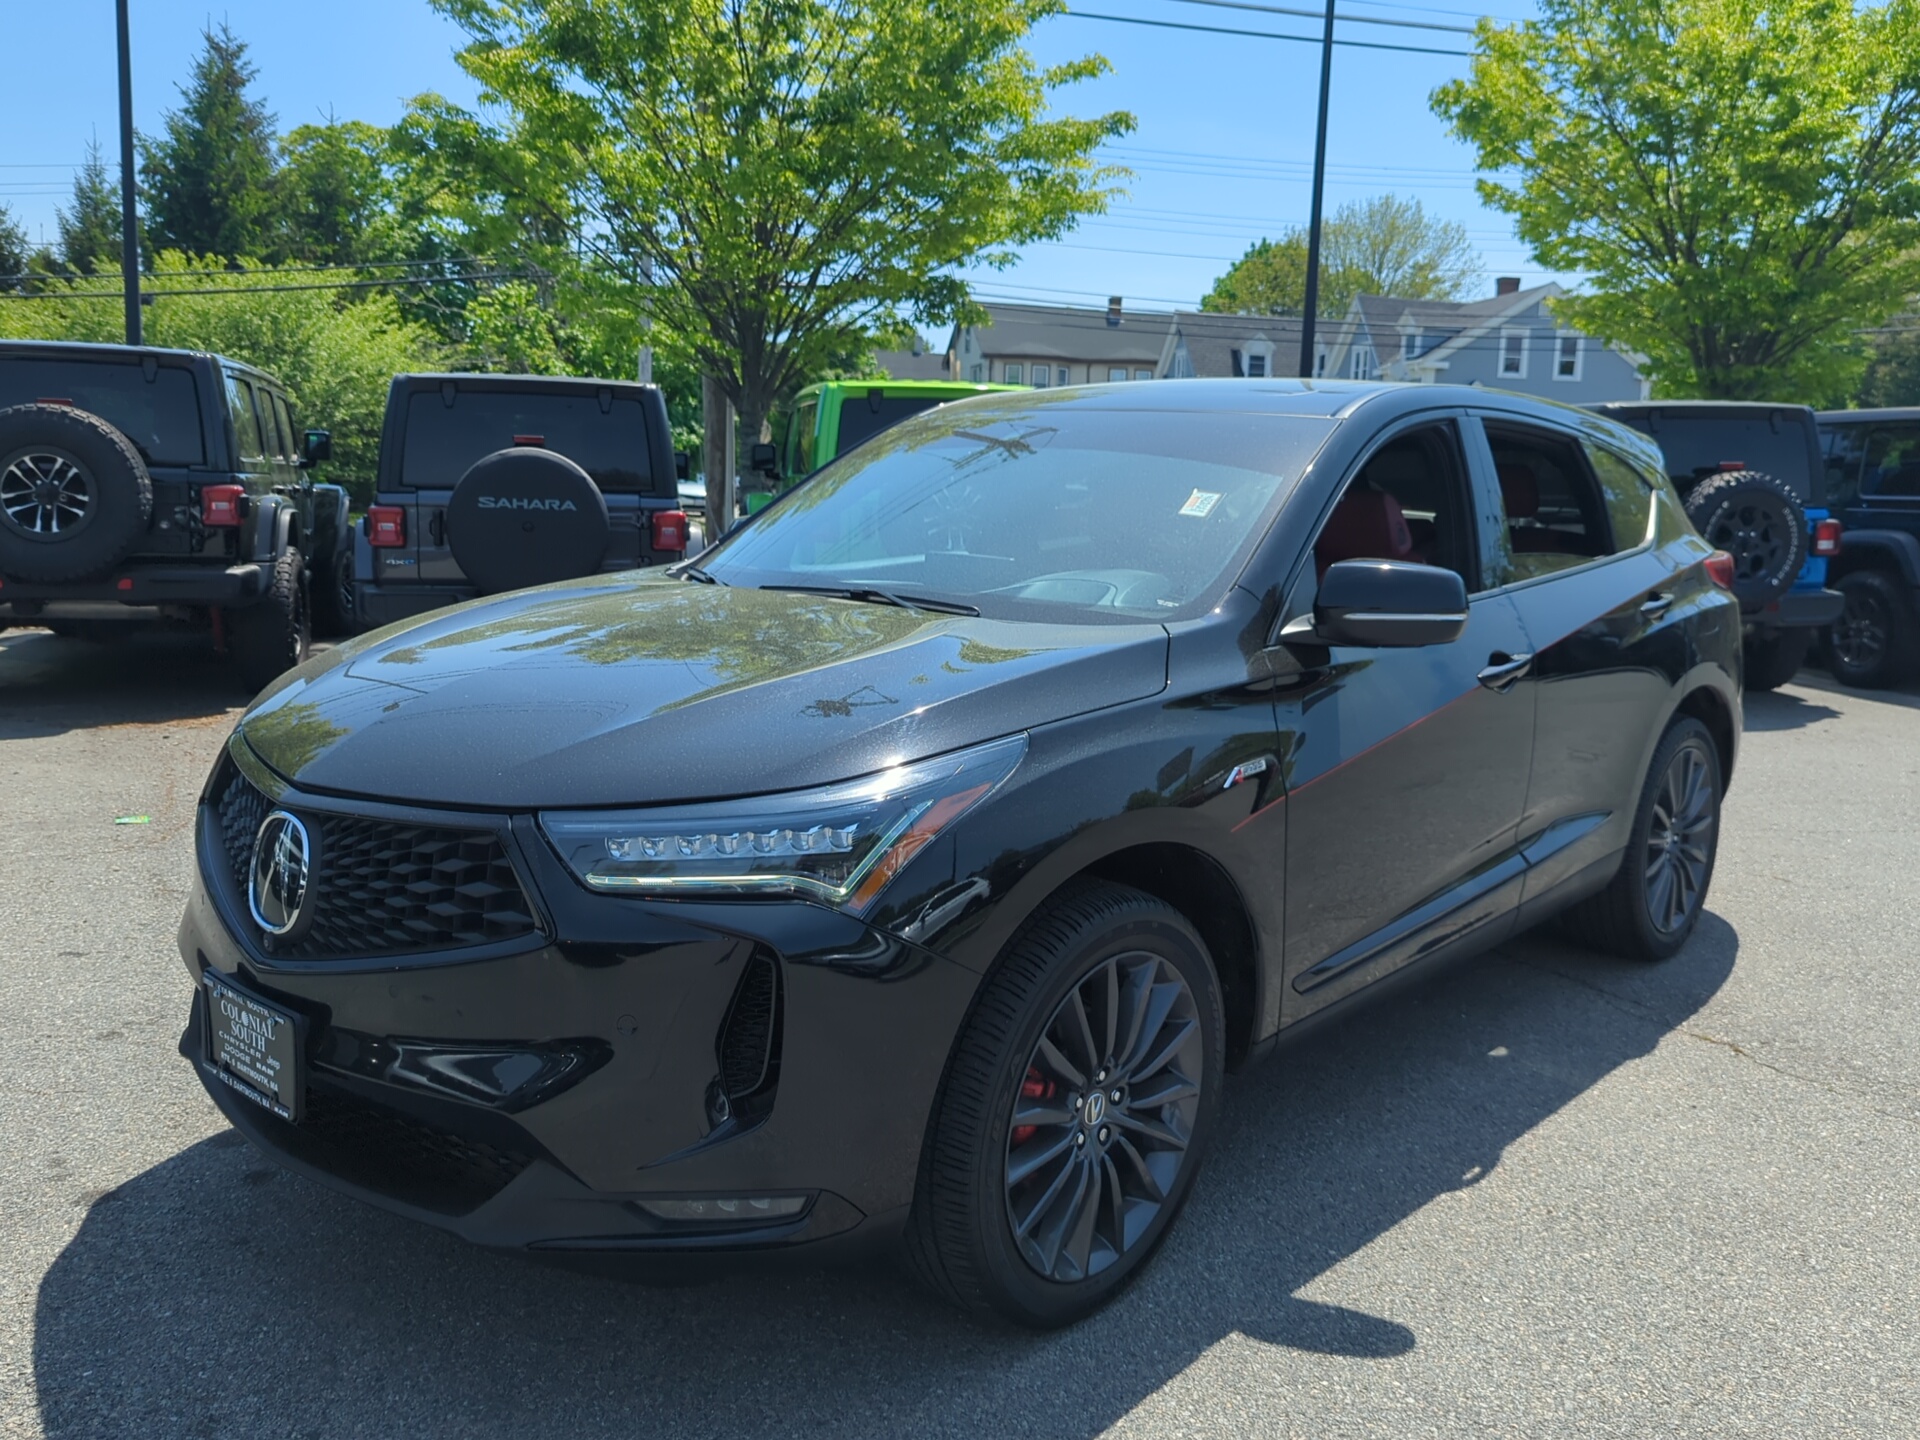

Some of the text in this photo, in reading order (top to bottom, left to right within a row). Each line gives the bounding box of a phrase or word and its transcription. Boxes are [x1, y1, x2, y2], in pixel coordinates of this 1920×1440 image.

[477, 496, 577, 511] SAHARA
[220, 1000, 275, 1041] COLONIAL
[231, 1020, 265, 1052] SOUTH
[219, 1030, 280, 1070] CHRYSLER Jeep
[224, 1042, 274, 1077] DODGE RAM
